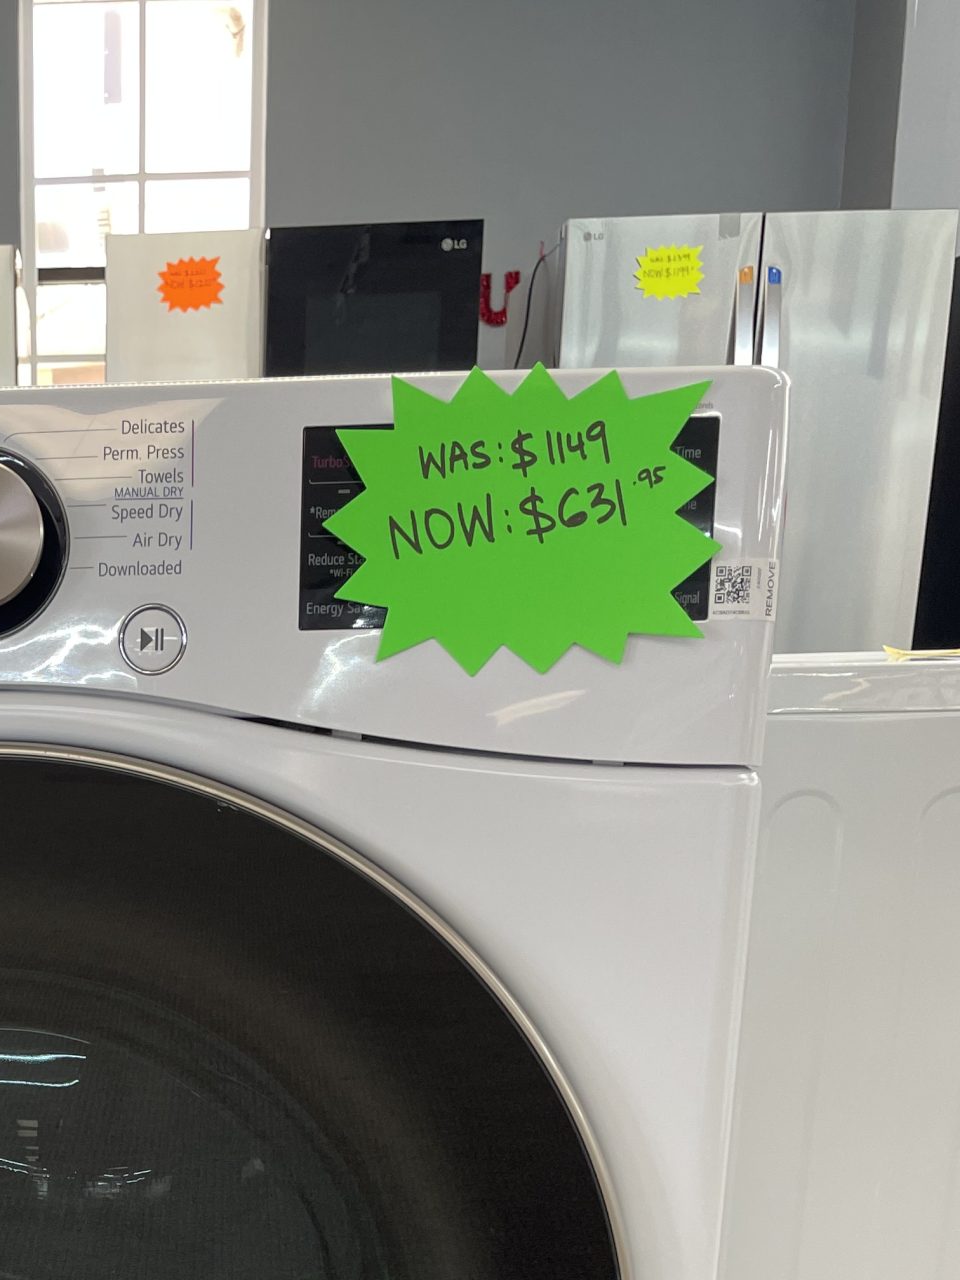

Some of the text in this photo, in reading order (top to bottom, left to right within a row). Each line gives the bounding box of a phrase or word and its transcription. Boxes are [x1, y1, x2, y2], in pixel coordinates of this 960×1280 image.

[454, 238, 468, 250] LG
[121, 418, 185, 435] Delicates
[103, 444, 185, 461] Perm. Press
[138, 467, 184, 484] Towels
[114, 486, 184, 498] MANUAL DRY
[111, 503, 183, 523] Speed Dry
[132, 531, 182, 551] Air Dry
[308, 552, 345, 566] Reduce
[98, 560, 182, 577] Downloaded
[765, 561, 777, 617] REMOVE
[306, 602, 344, 618] Energy
